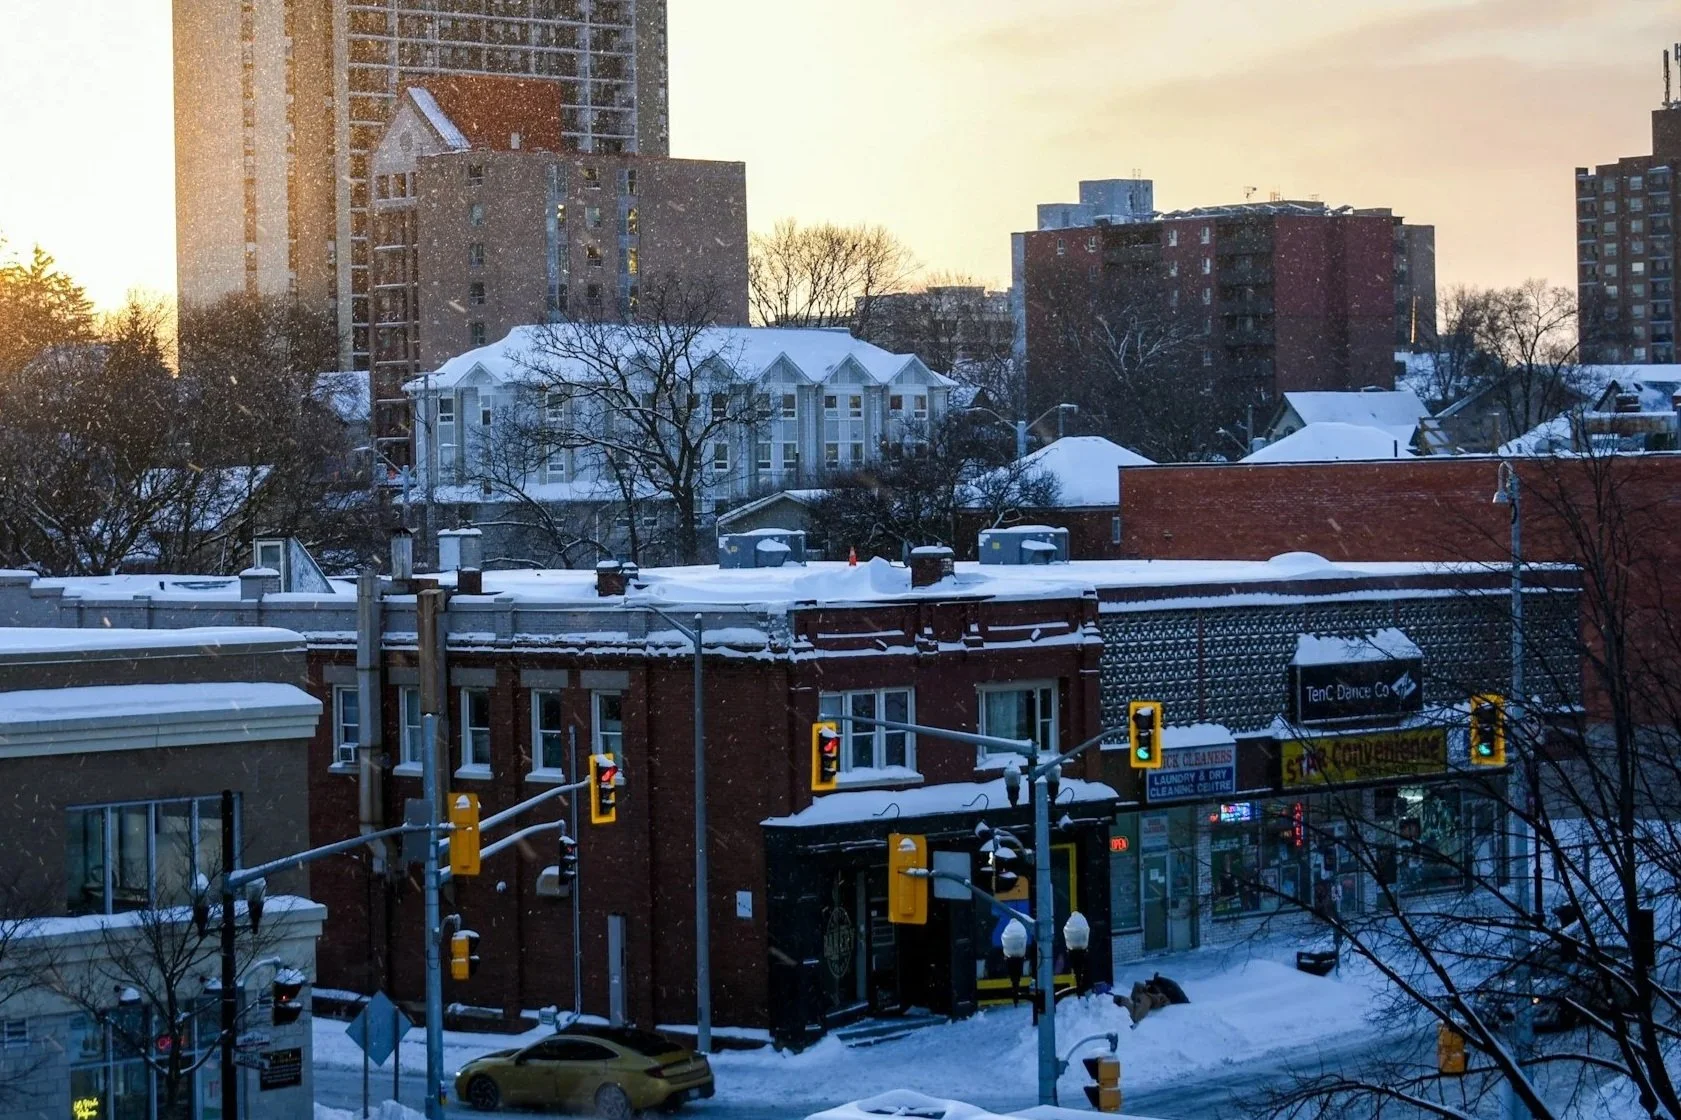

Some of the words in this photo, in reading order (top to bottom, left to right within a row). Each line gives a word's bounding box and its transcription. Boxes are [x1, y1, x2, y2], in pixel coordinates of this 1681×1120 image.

[1305, 685, 1334, 702] TenC
[1337, 683, 1371, 701] Dance
[1375, 681, 1389, 698] Co
[1183, 749, 1232, 767] CLEANERS
[1154, 771, 1196, 787] LAUNDRY
[1199, 769, 1206, 781] &
[1209, 767, 1227, 781] DRY
[1149, 783, 1195, 798] CLEANING
[1197, 779, 1232, 793] CENTRE
